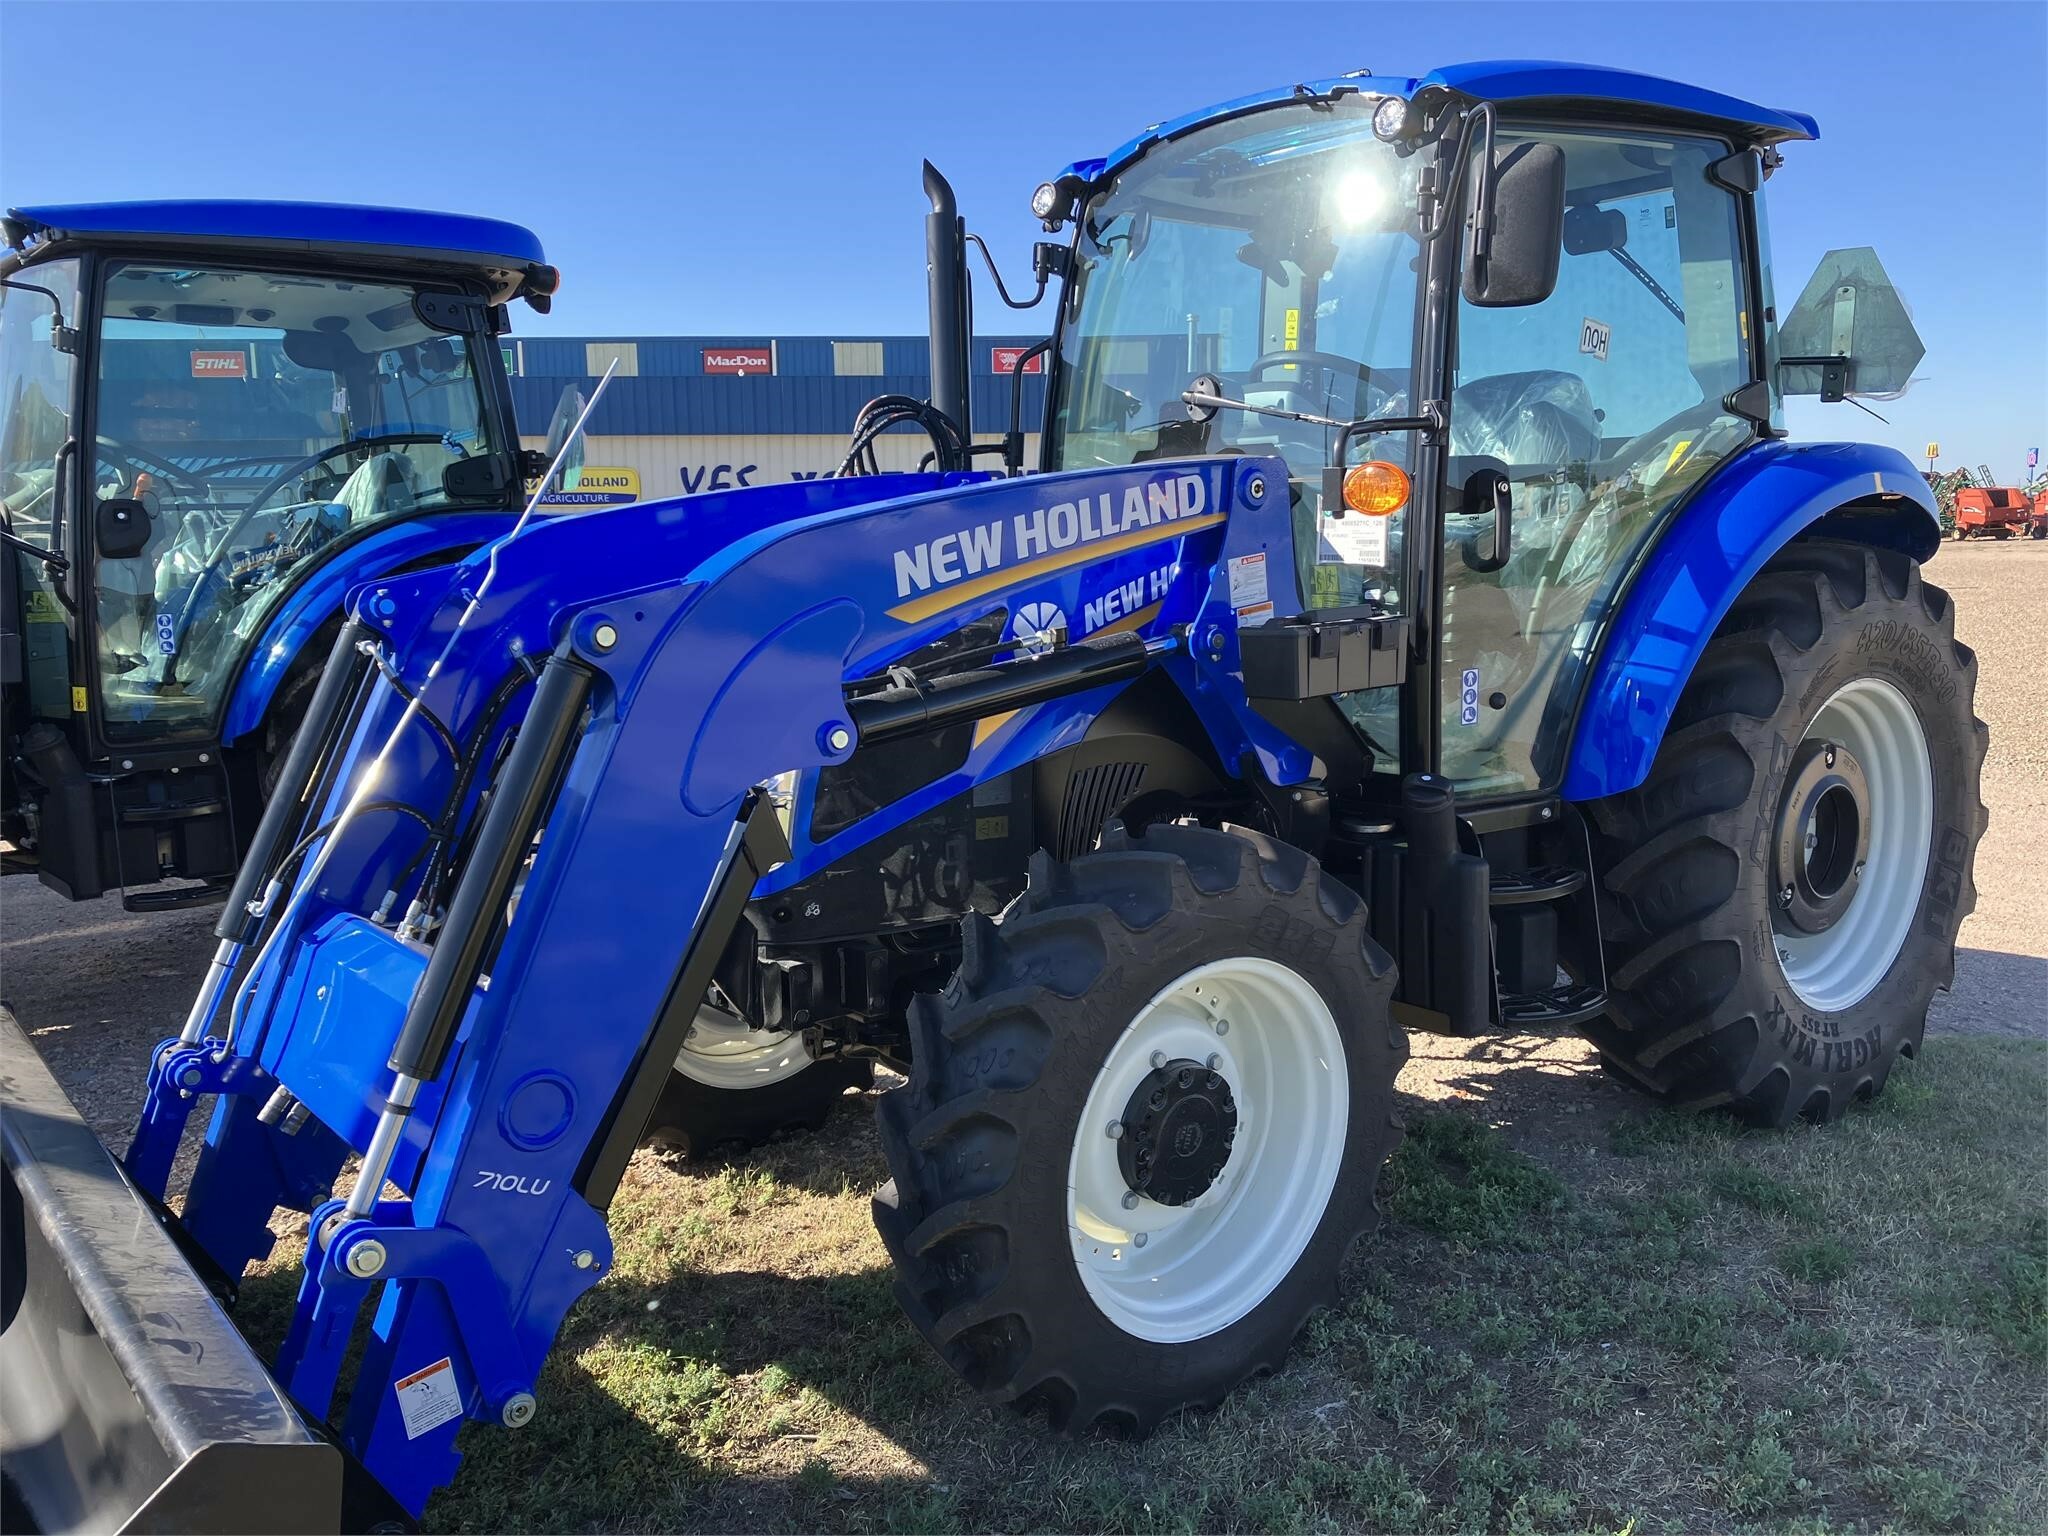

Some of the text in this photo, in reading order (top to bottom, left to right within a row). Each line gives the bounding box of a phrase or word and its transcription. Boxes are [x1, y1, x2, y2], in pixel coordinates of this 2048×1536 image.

[194, 358, 240, 369] STIHL
[706, 355, 767, 366] MacDon
[541, 494, 610, 503] AGRICULTURE
[893, 473, 1206, 598] NEW HOLLAND
[1084, 575, 1145, 633] NEW
[1922, 824, 1969, 944] BKT
[1763, 993, 1881, 1074] AGRIMAX
[472, 1170, 552, 1196] 710LU
